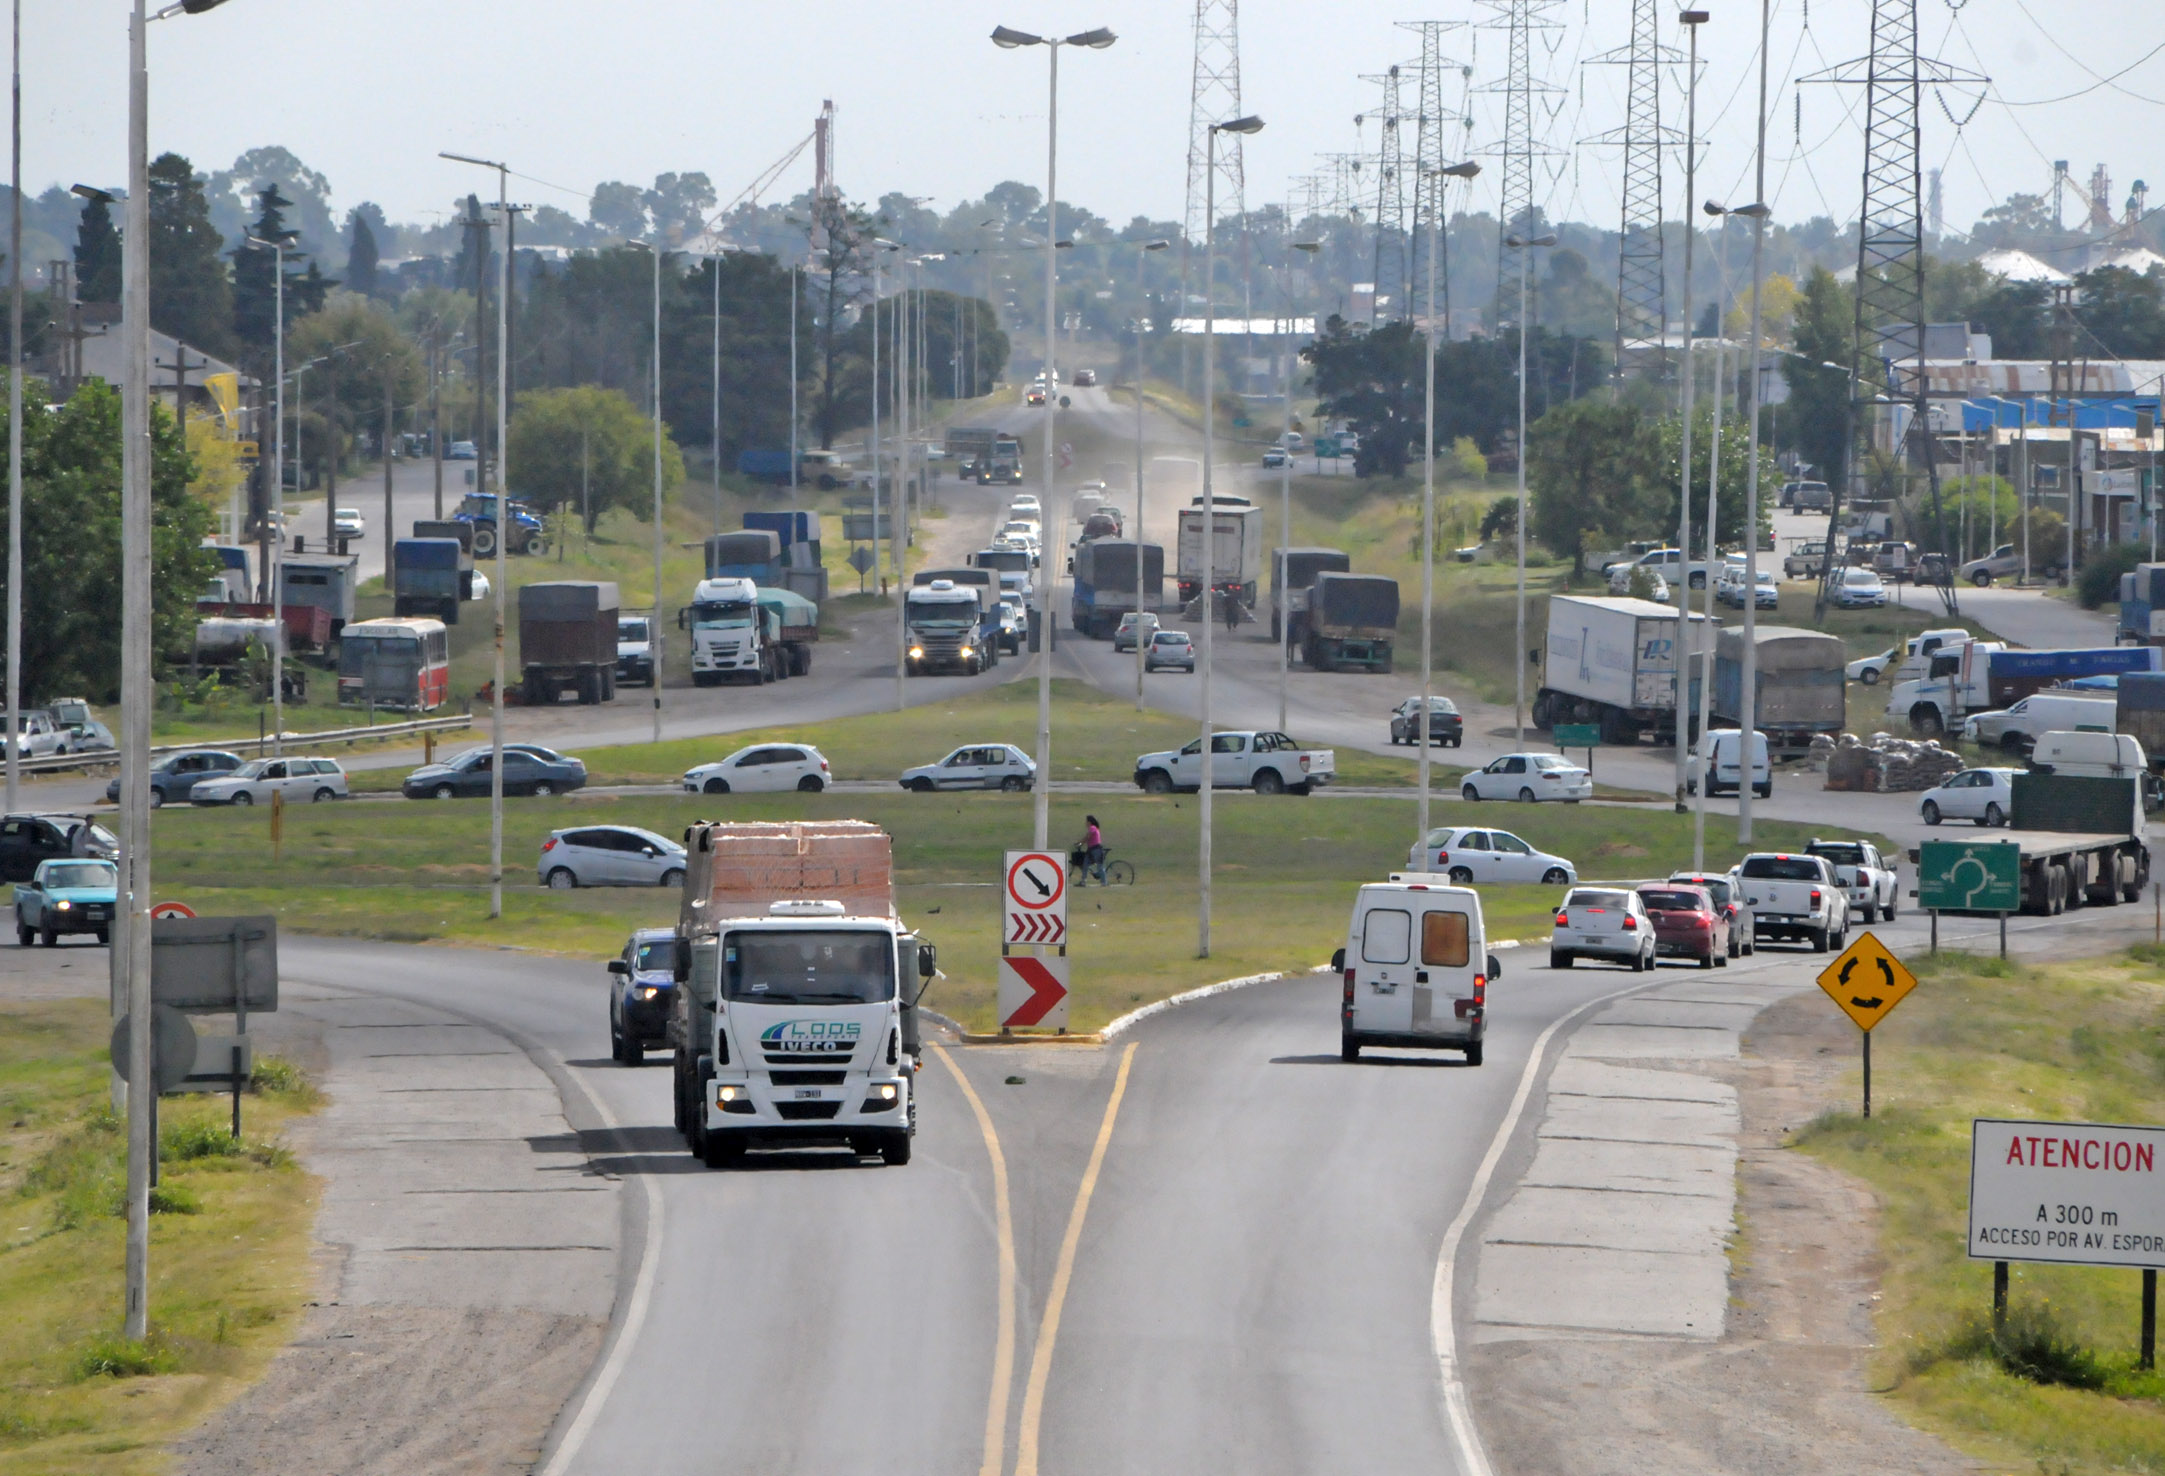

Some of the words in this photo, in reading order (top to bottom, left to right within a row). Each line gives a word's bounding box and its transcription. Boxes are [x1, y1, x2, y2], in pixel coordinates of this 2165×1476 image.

[791, 1023, 861, 1034] LOOS
[780, 1041, 837, 1052] IVECO
[2007, 1136, 2153, 1171] ATENCION
[2036, 1203, 2048, 1223] A
[2055, 1204, 2094, 1226] 300
[2101, 1211, 2119, 1227] m
[1979, 1226, 2041, 1246] ACCESO
[2047, 1231, 2078, 1249] POR
[2084, 1233, 2108, 1250] AV.
[2113, 1234, 2165, 1253] ESPOR
